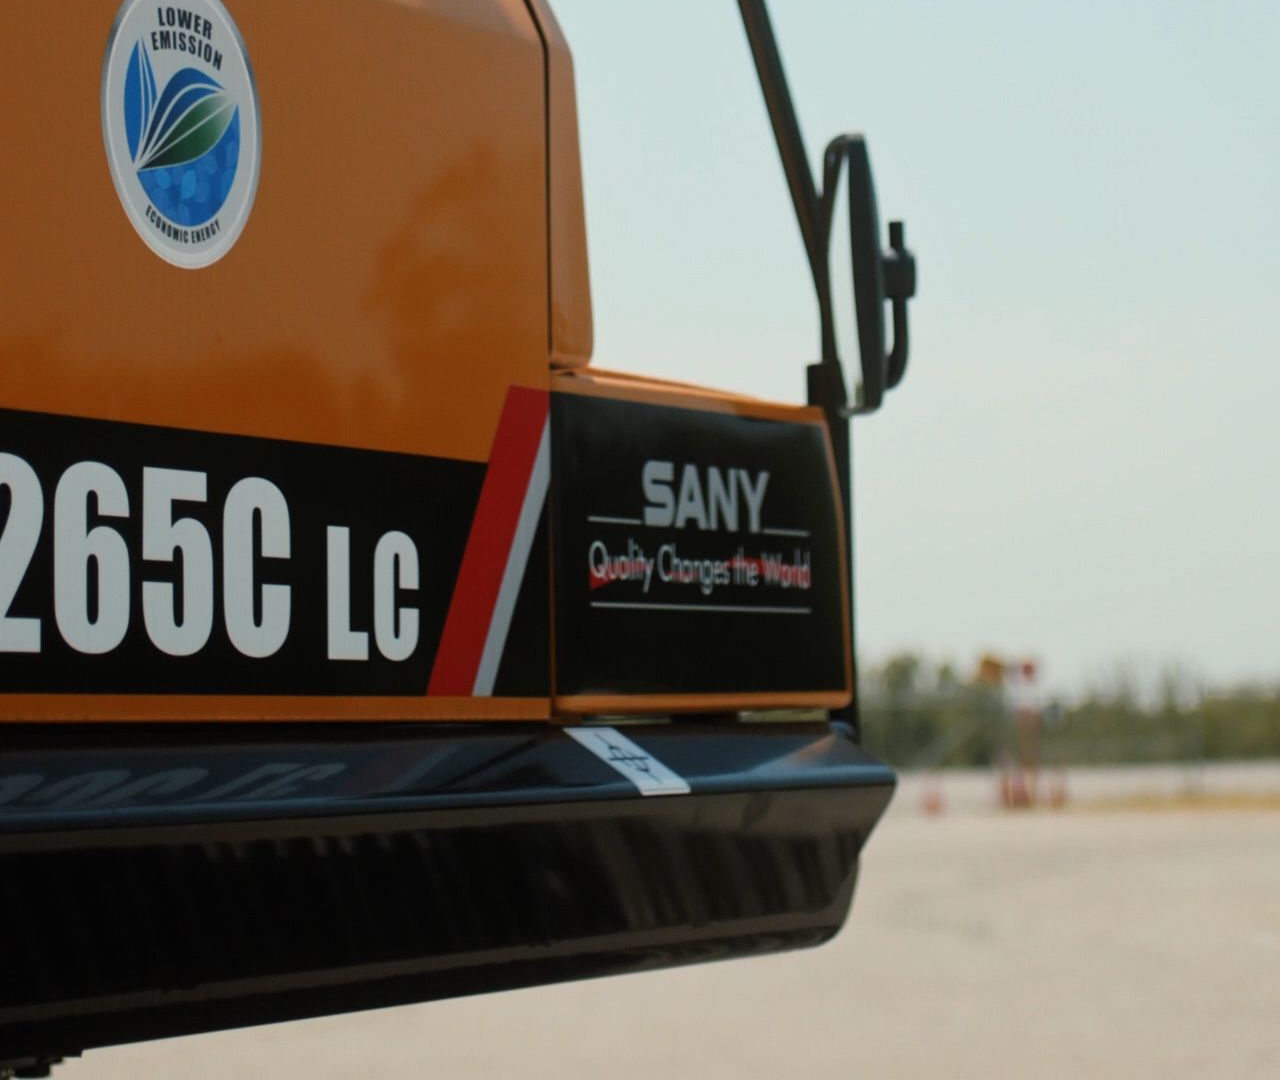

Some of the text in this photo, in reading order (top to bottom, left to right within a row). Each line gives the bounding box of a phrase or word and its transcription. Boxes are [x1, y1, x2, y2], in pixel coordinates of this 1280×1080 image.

[157, 7, 213, 41] LOWER
[151, 30, 223, 72] EMISSION
[145, 204, 221, 244] ECONOMIC ENERGY
[642, 459, 770, 533] SANY
[588, 539, 812, 596] Quality Changes the World
[327, 524, 420, 662] LC
